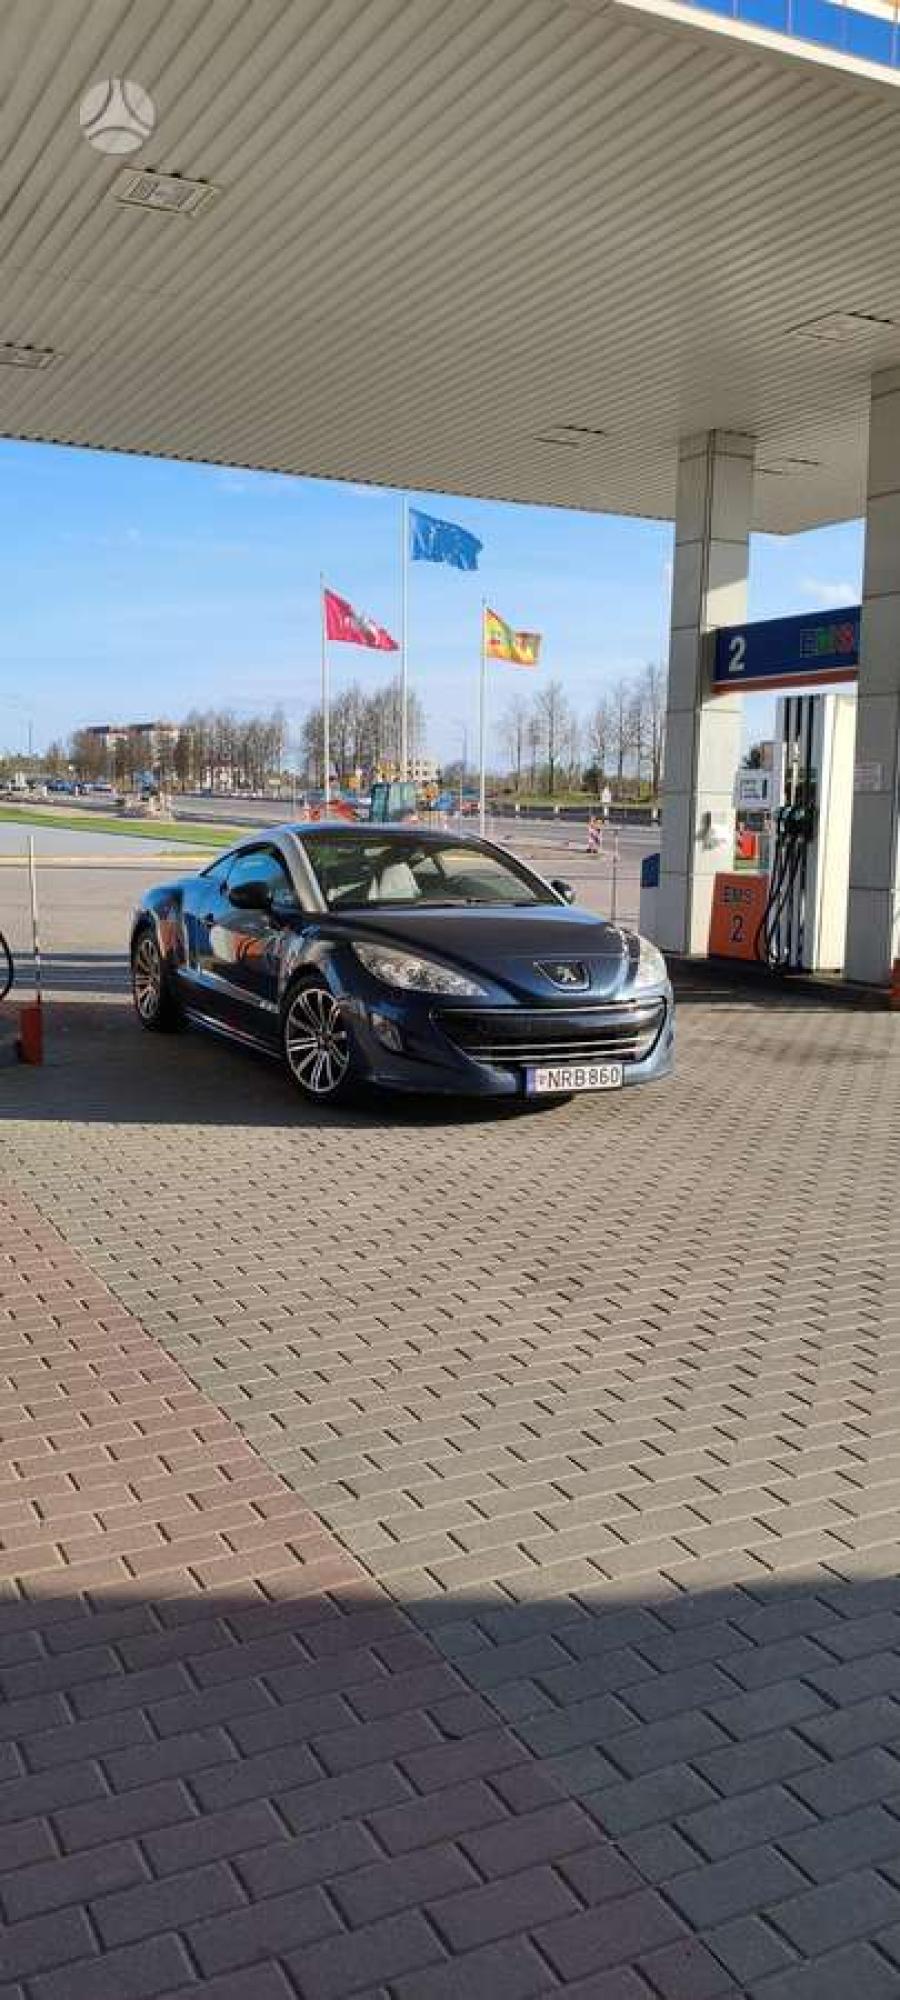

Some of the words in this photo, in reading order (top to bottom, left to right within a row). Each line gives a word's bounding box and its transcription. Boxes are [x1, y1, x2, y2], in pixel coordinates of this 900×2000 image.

[729, 635, 746, 671] 2
[722, 886, 752, 904] EMS
[729, 914, 744, 942] 2
